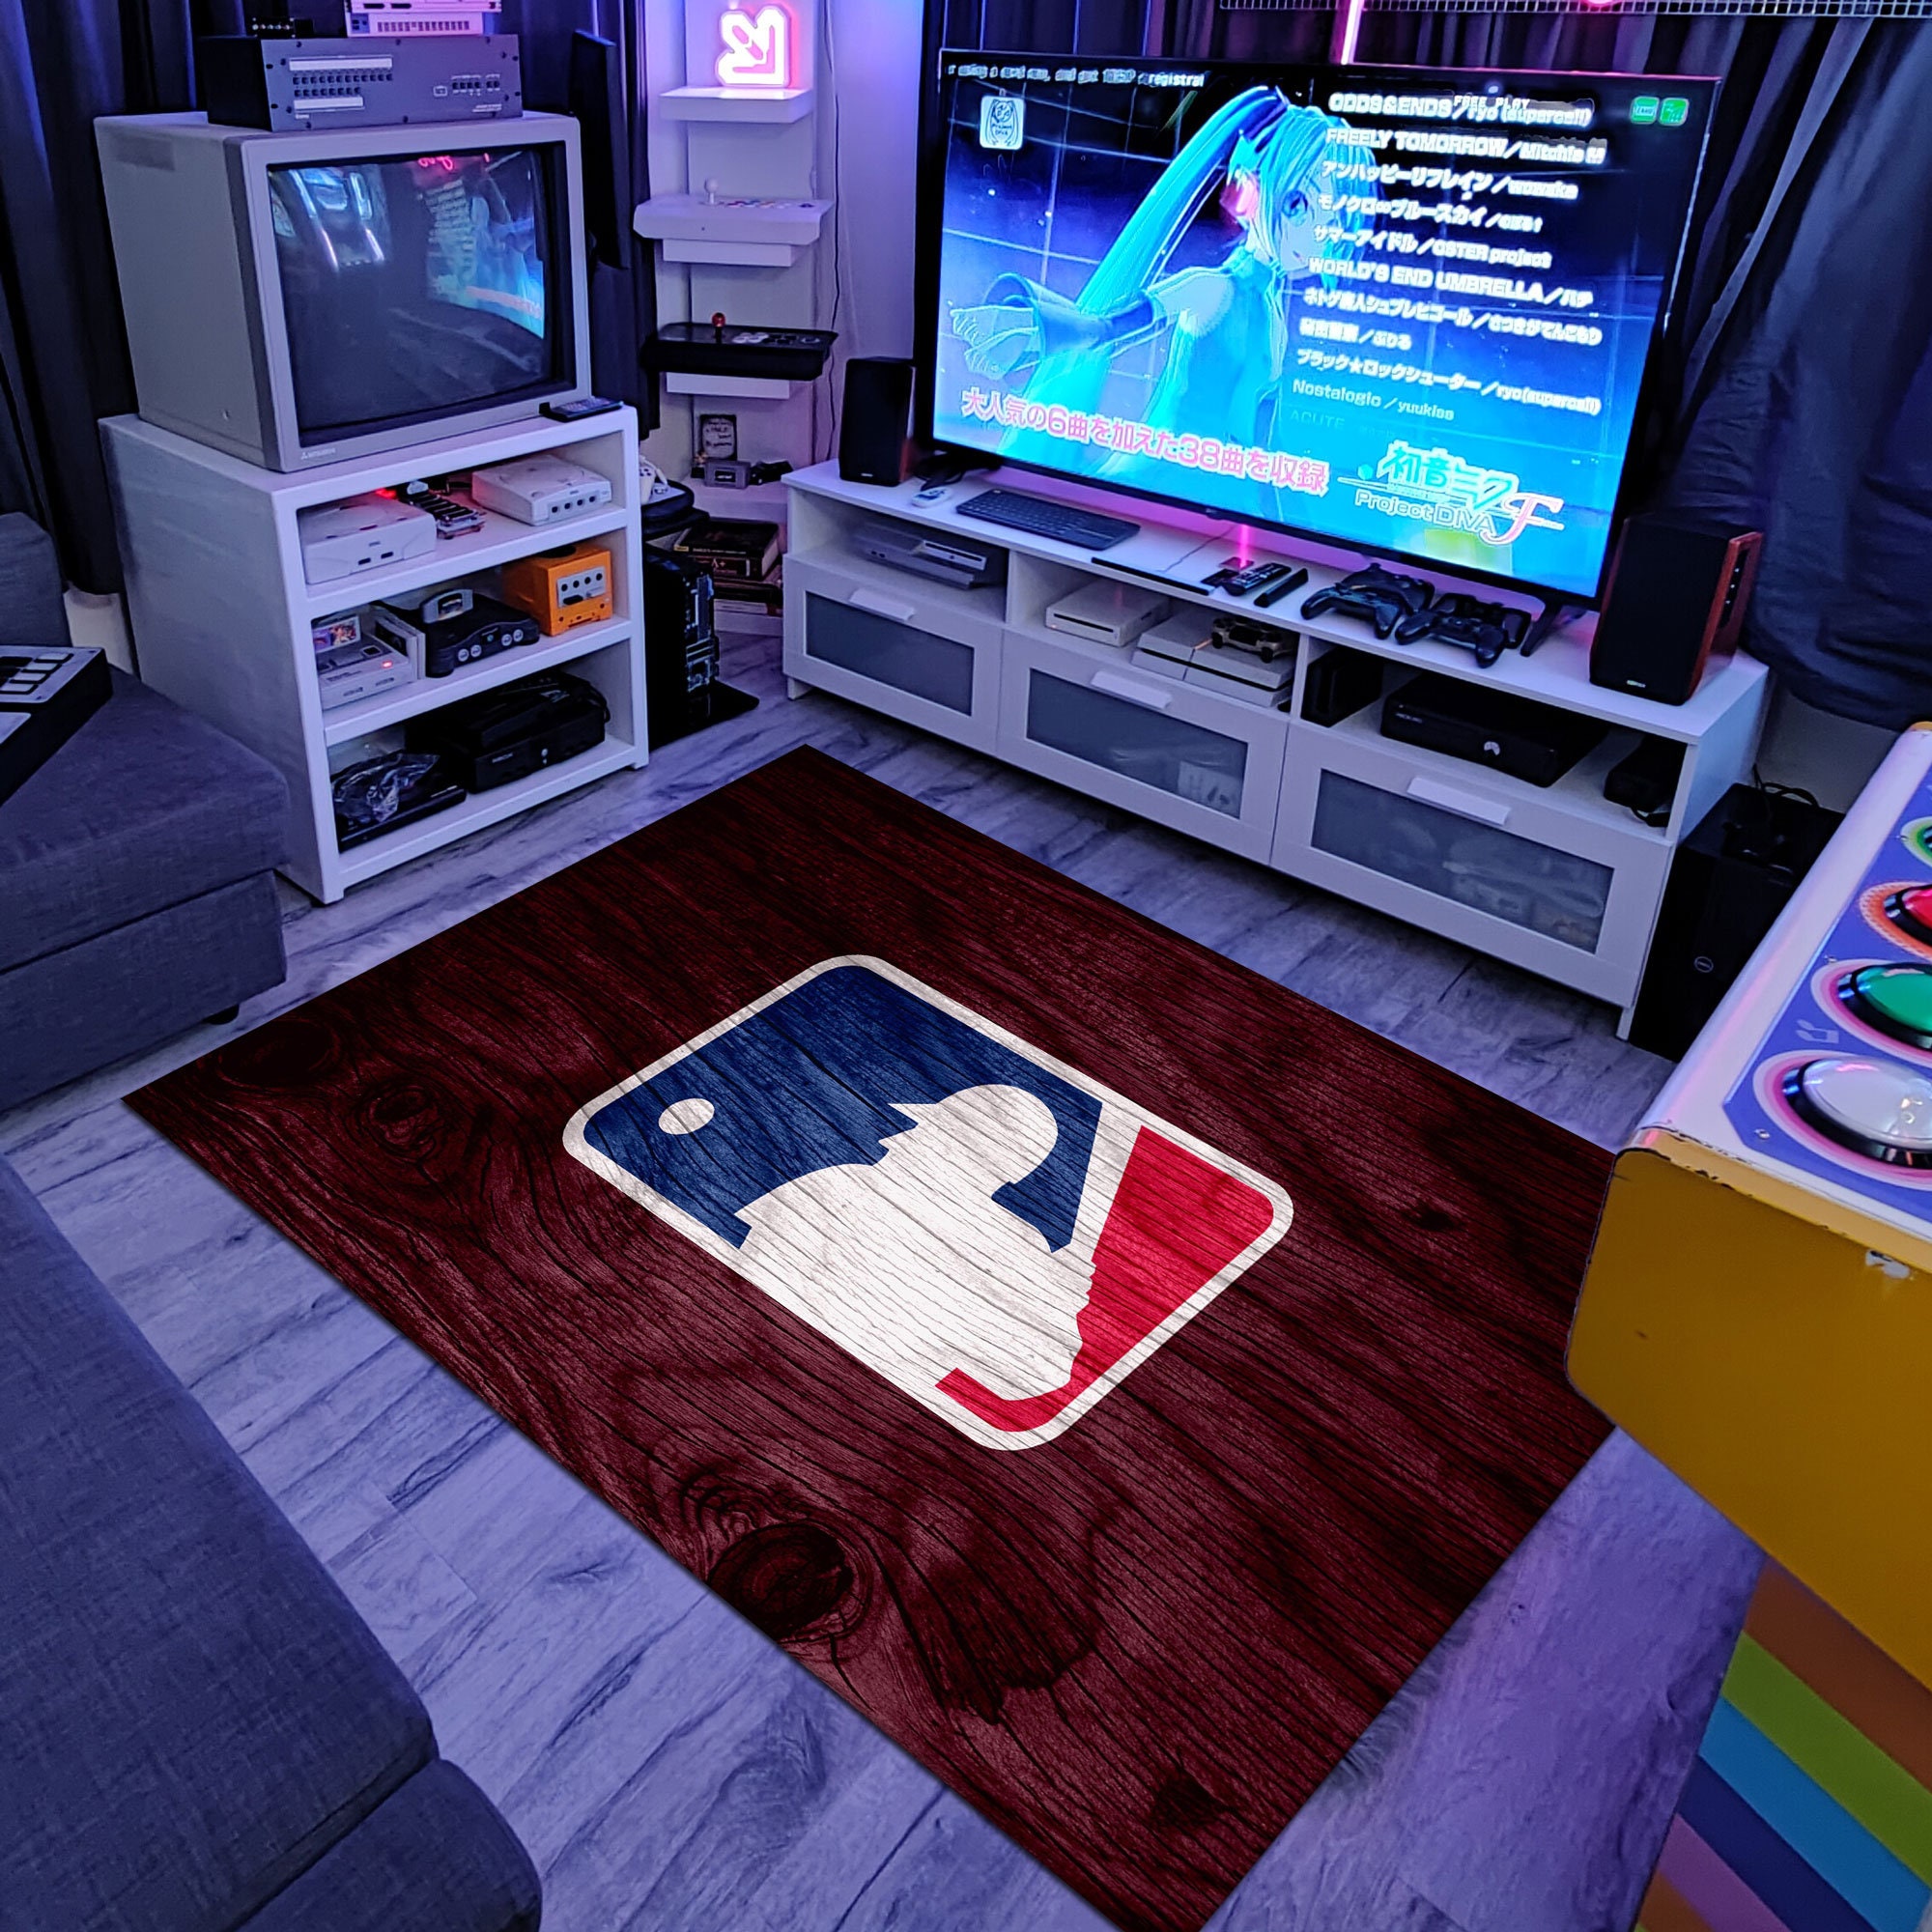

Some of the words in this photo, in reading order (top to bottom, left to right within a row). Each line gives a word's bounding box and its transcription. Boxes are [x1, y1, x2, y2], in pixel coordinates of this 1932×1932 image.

[1326, 128, 1394, 150] FREELY
[1308, 257, 1391, 283] WORLD'S
[1391, 265, 1434, 288] END
[1488, 247, 1553, 270] project
[1293, 378, 1382, 407] Nostalogic
[1376, 440, 1520, 512] 初音ミク
[1355, 489, 1434, 522] Project
